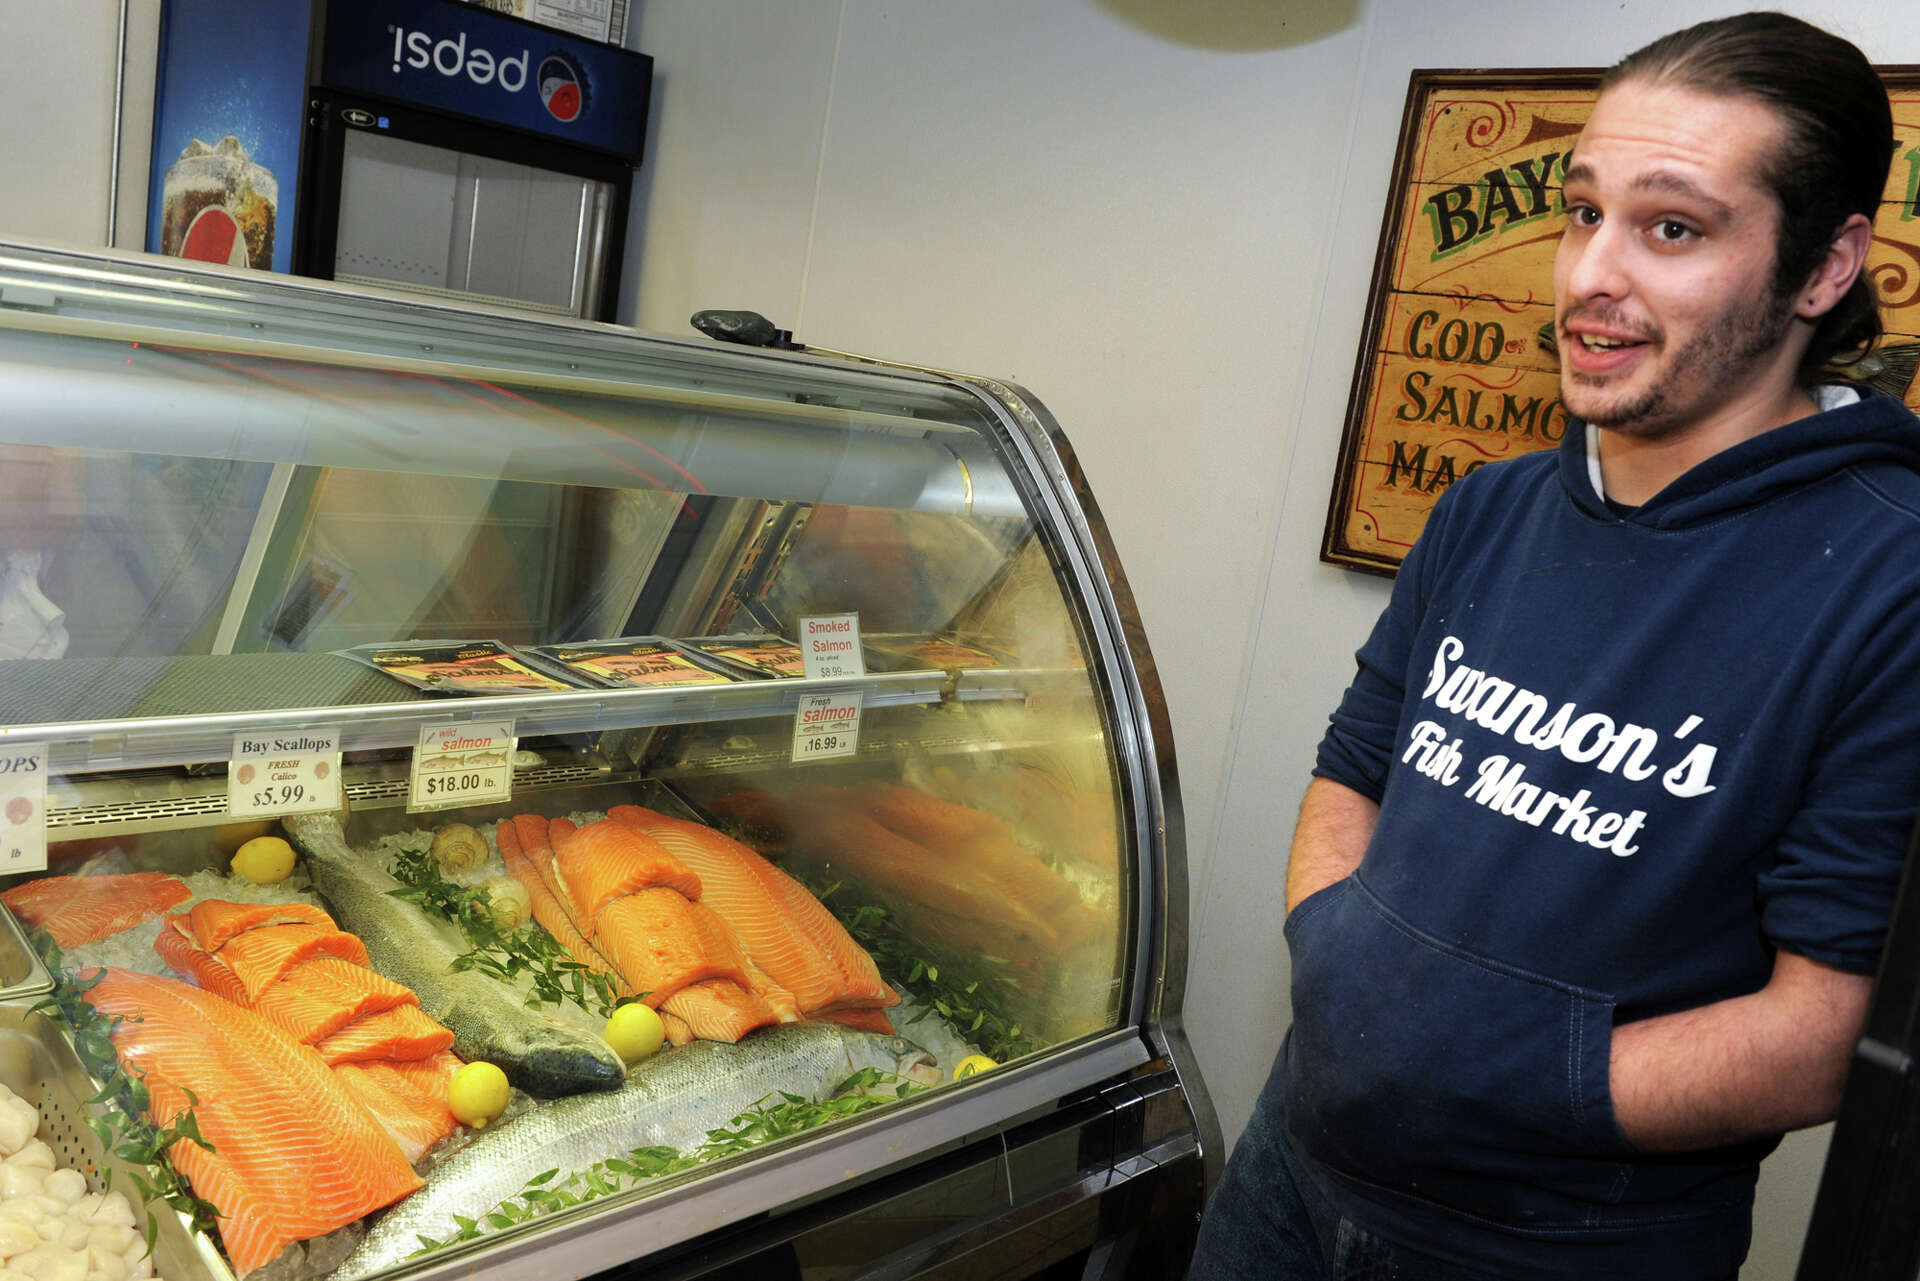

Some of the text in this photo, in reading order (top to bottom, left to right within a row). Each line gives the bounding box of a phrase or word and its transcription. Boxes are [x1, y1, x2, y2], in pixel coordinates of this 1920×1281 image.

[391, 27, 530, 93] pepsi
[1405, 309, 1506, 366] COD
[808, 619, 850, 634] Smoked
[813, 640, 852, 652] Salmon
[811, 697, 831, 706] Fresh
[803, 706, 857, 722] salmon
[1421, 636, 1718, 798] Swanson's
[440, 728, 457, 738] wild
[241, 737, 331, 755] Bay Scallops
[441, 736, 492, 751] salmon
[267, 760, 301, 769] FRESH
[271, 773, 297, 781] Calico
[427, 774, 479, 795] $18.00
[253, 784, 304, 806] $5.99
[1401, 720, 1648, 857] Fish Market
[11, 848, 21, 858] lb
